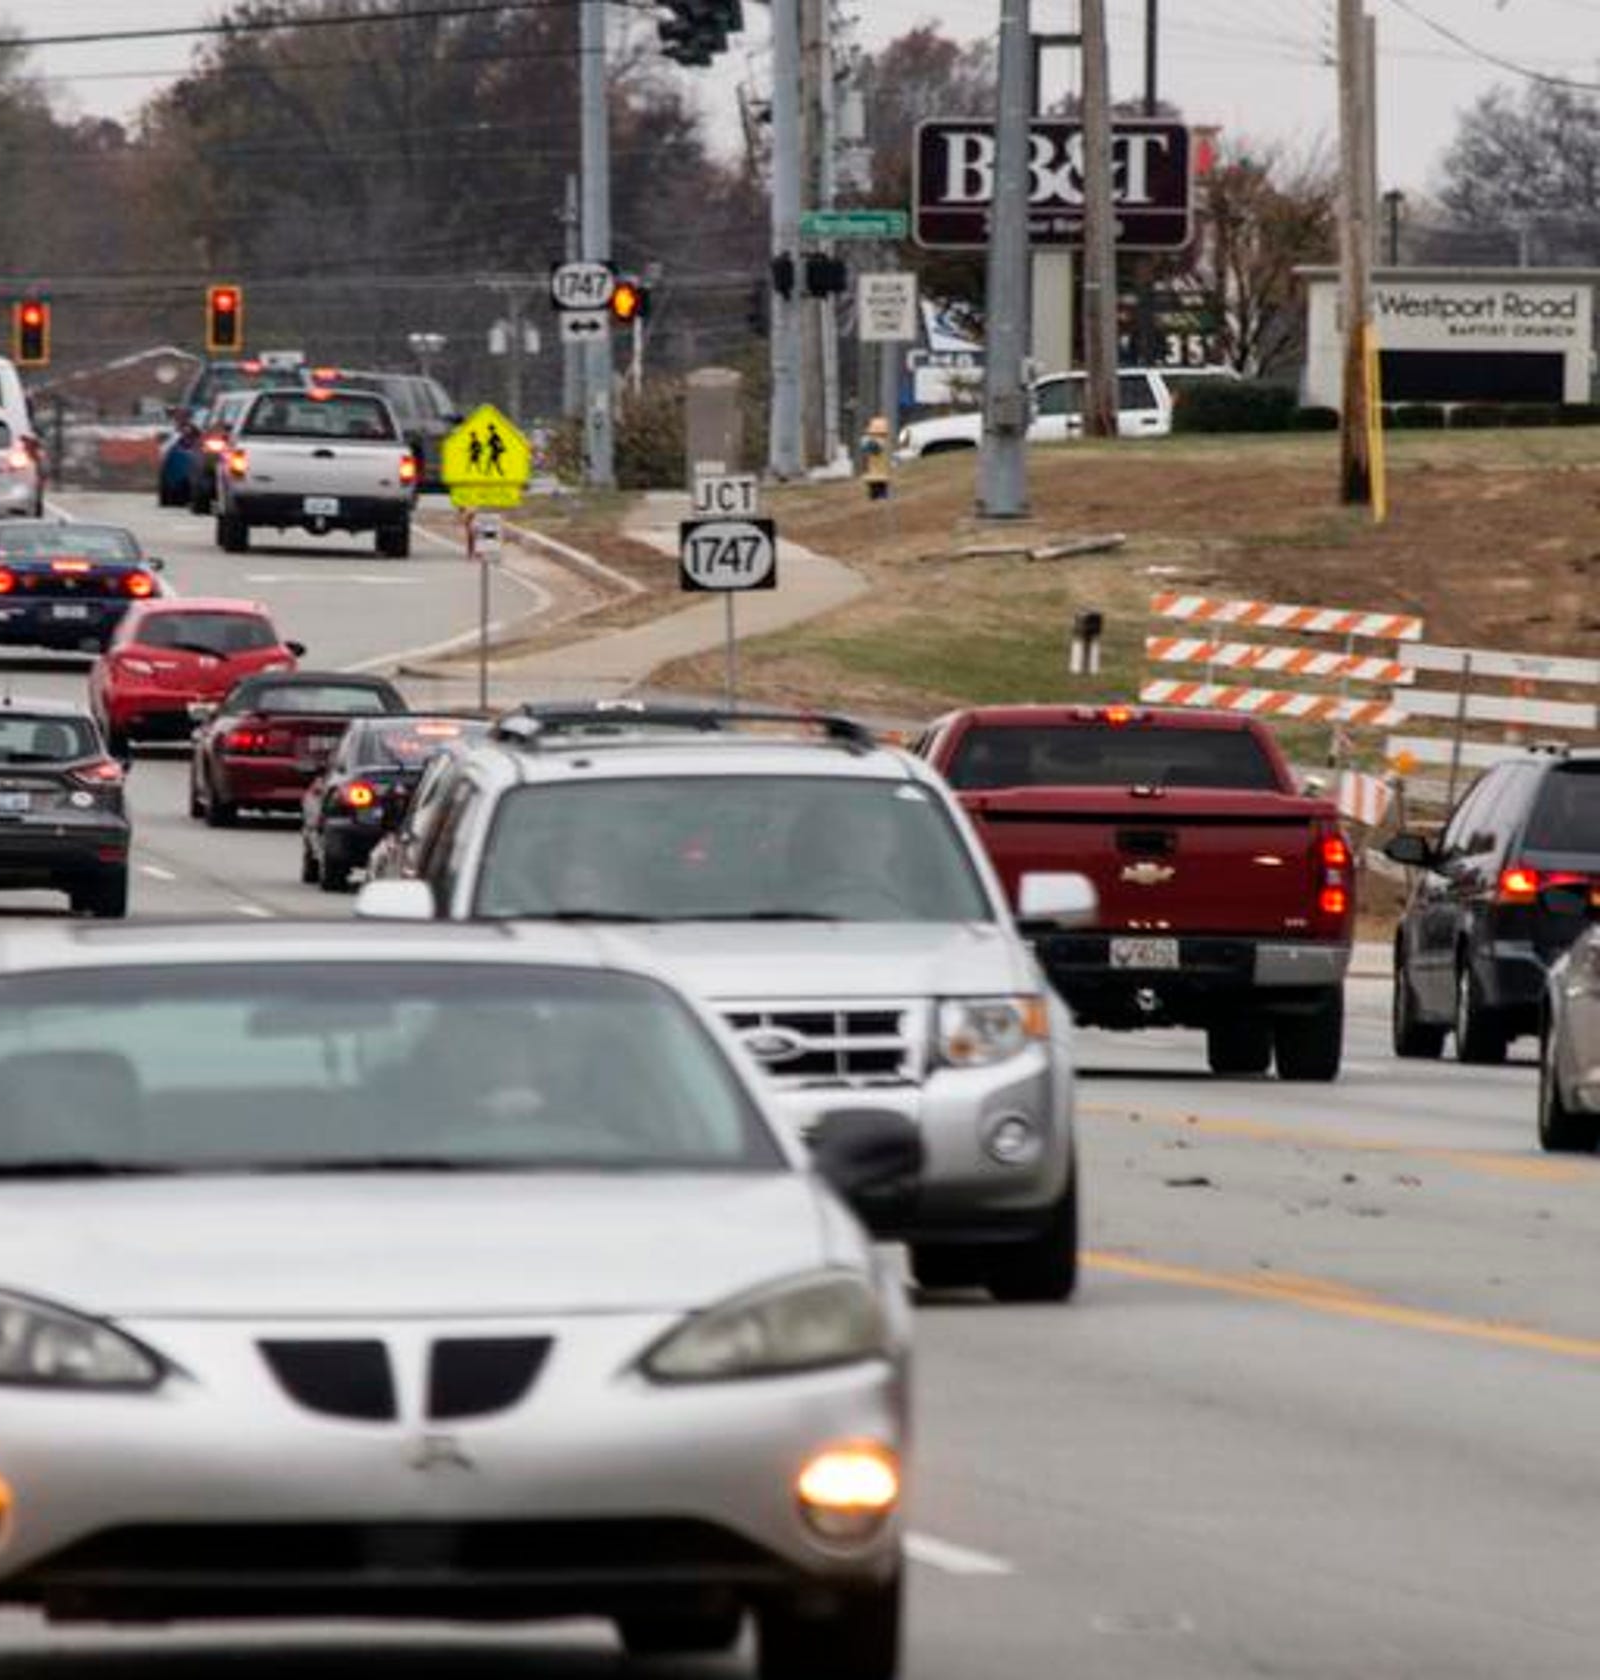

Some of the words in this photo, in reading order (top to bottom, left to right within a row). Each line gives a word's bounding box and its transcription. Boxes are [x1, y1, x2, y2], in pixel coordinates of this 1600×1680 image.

[558, 271, 609, 300] 1747
[1377, 291, 1496, 321] Westport
[1503, 291, 1577, 318] Road
[1447, 324, 1508, 338] BAPTIST
[1512, 324, 1576, 338] CHURCH
[693, 481, 753, 512] JCT
[690, 535, 763, 575] 1747
